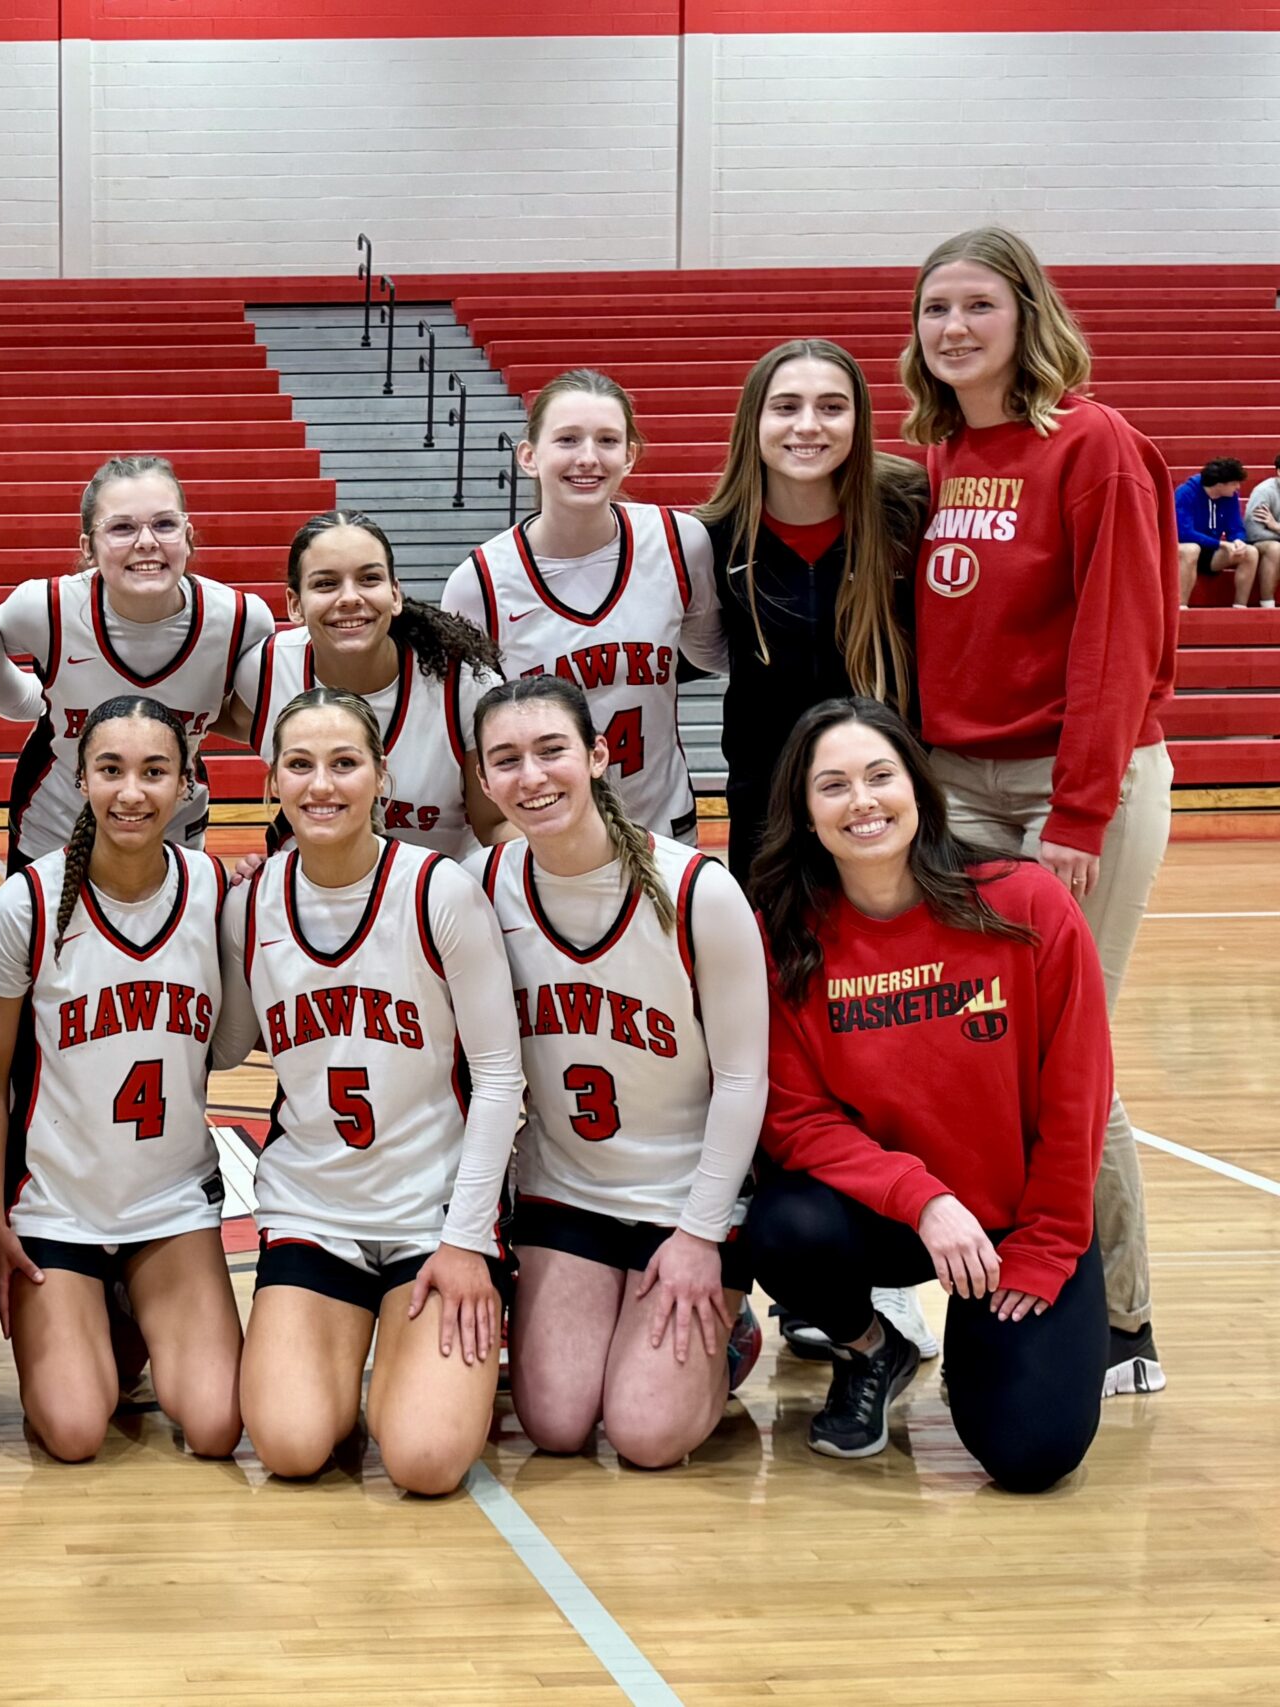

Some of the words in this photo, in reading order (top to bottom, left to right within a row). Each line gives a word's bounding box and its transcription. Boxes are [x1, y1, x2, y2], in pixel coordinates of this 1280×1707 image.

[923, 508, 1018, 541] AWKS
[58, 980, 214, 1050] HAWKS
[827, 962, 945, 1000] UNIVERSITY
[827, 976, 1008, 1033] BASKETBALL
[266, 985, 425, 1057] HAWKS
[112, 1058, 166, 1141] 4
[327, 1066, 376, 1150] 5
[563, 1063, 622, 1142] 3
